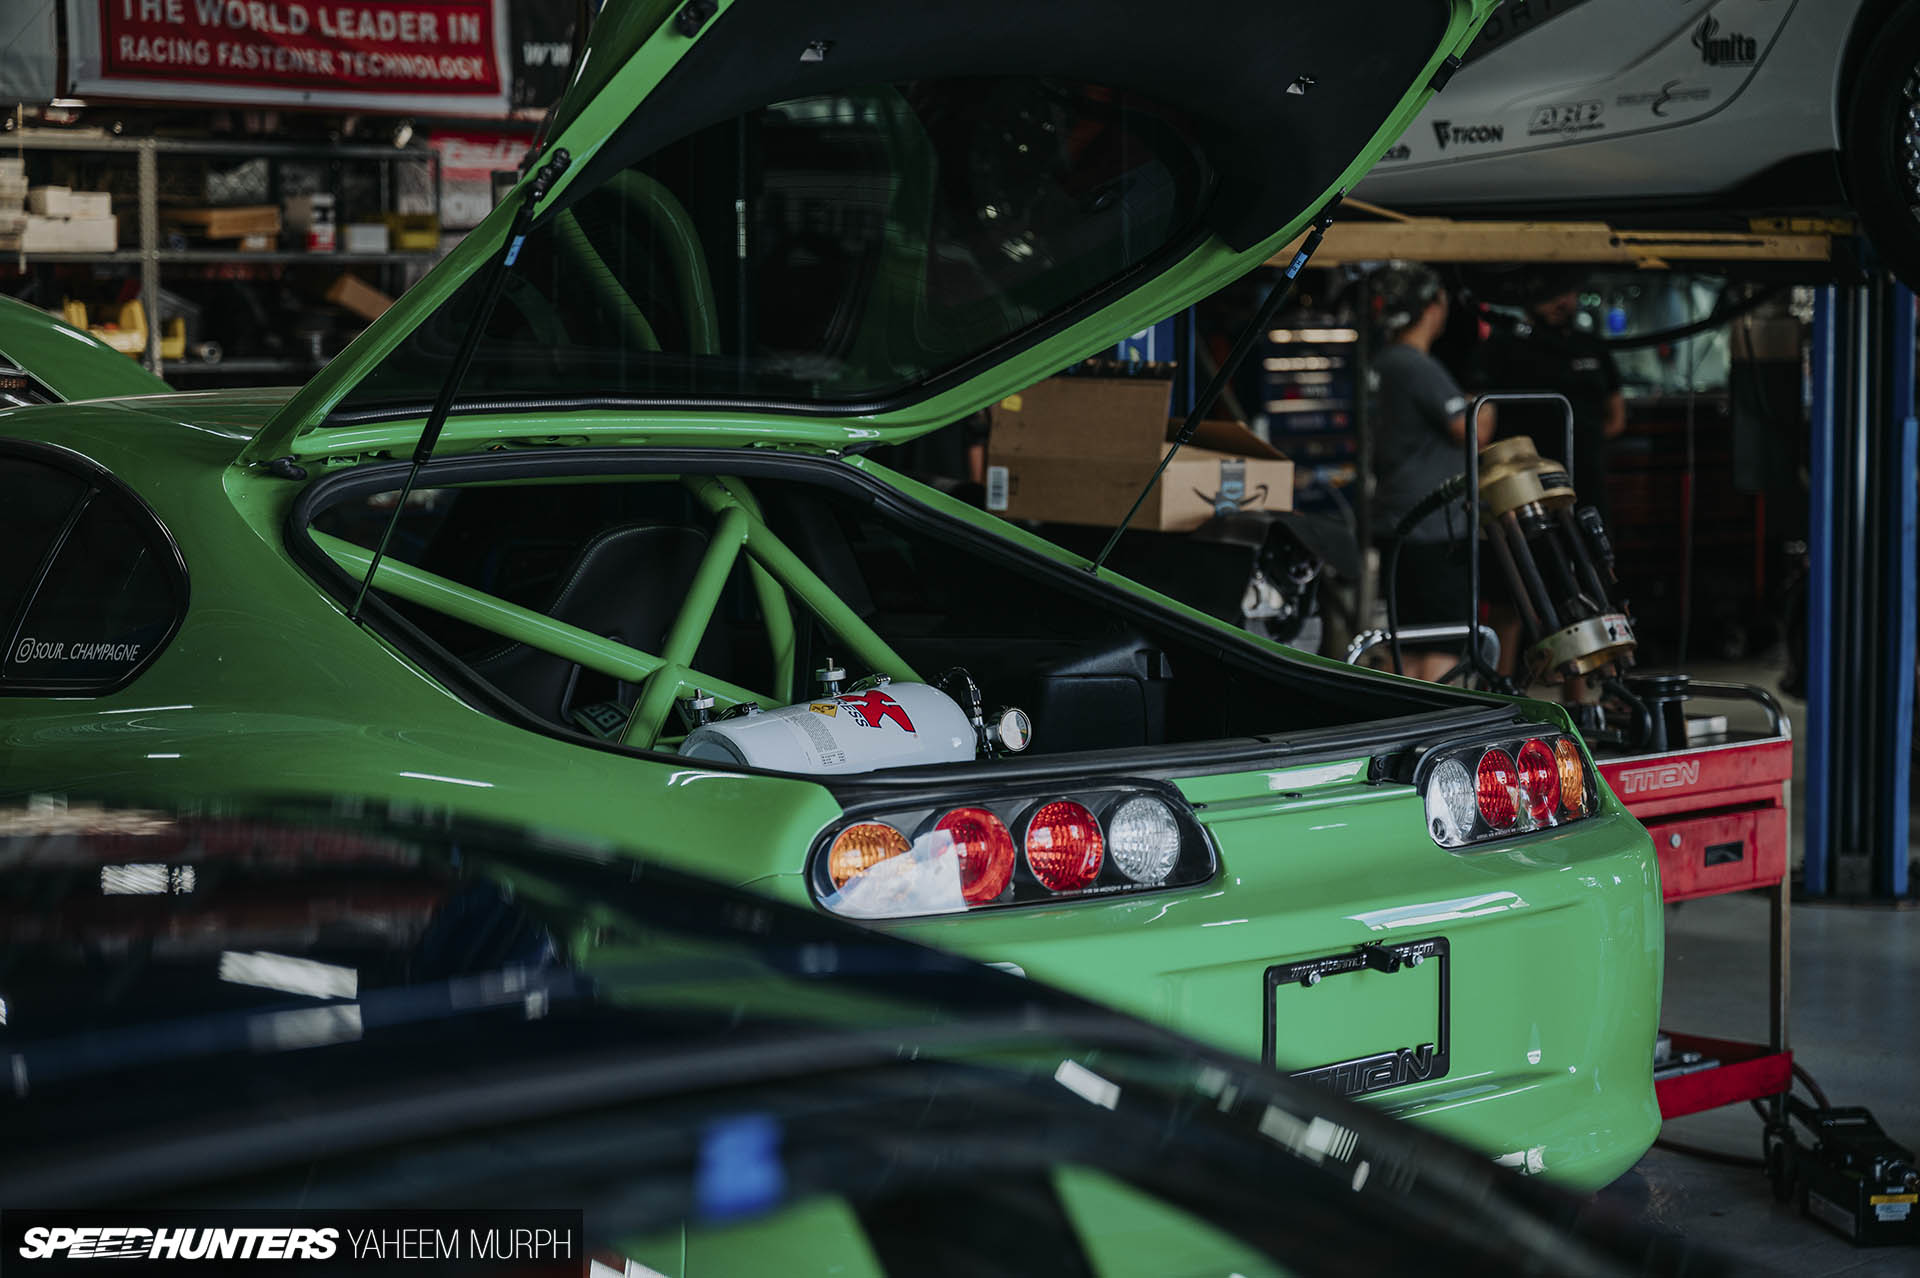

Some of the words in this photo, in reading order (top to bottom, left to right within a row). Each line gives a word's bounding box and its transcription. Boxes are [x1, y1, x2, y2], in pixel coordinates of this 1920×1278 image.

[121, 0, 185, 24] THE
[195, 0, 310, 35] WORLD
[317, 7, 438, 43] LEADER
[447, 13, 481, 44] IN
[119, 35, 210, 66] RACING
[217, 42, 336, 75] FASTENER
[338, 51, 484, 80] TECHNOLOGY
[1451, 124, 1504, 144] TICON
[1619, 759, 1700, 794] TITAN
